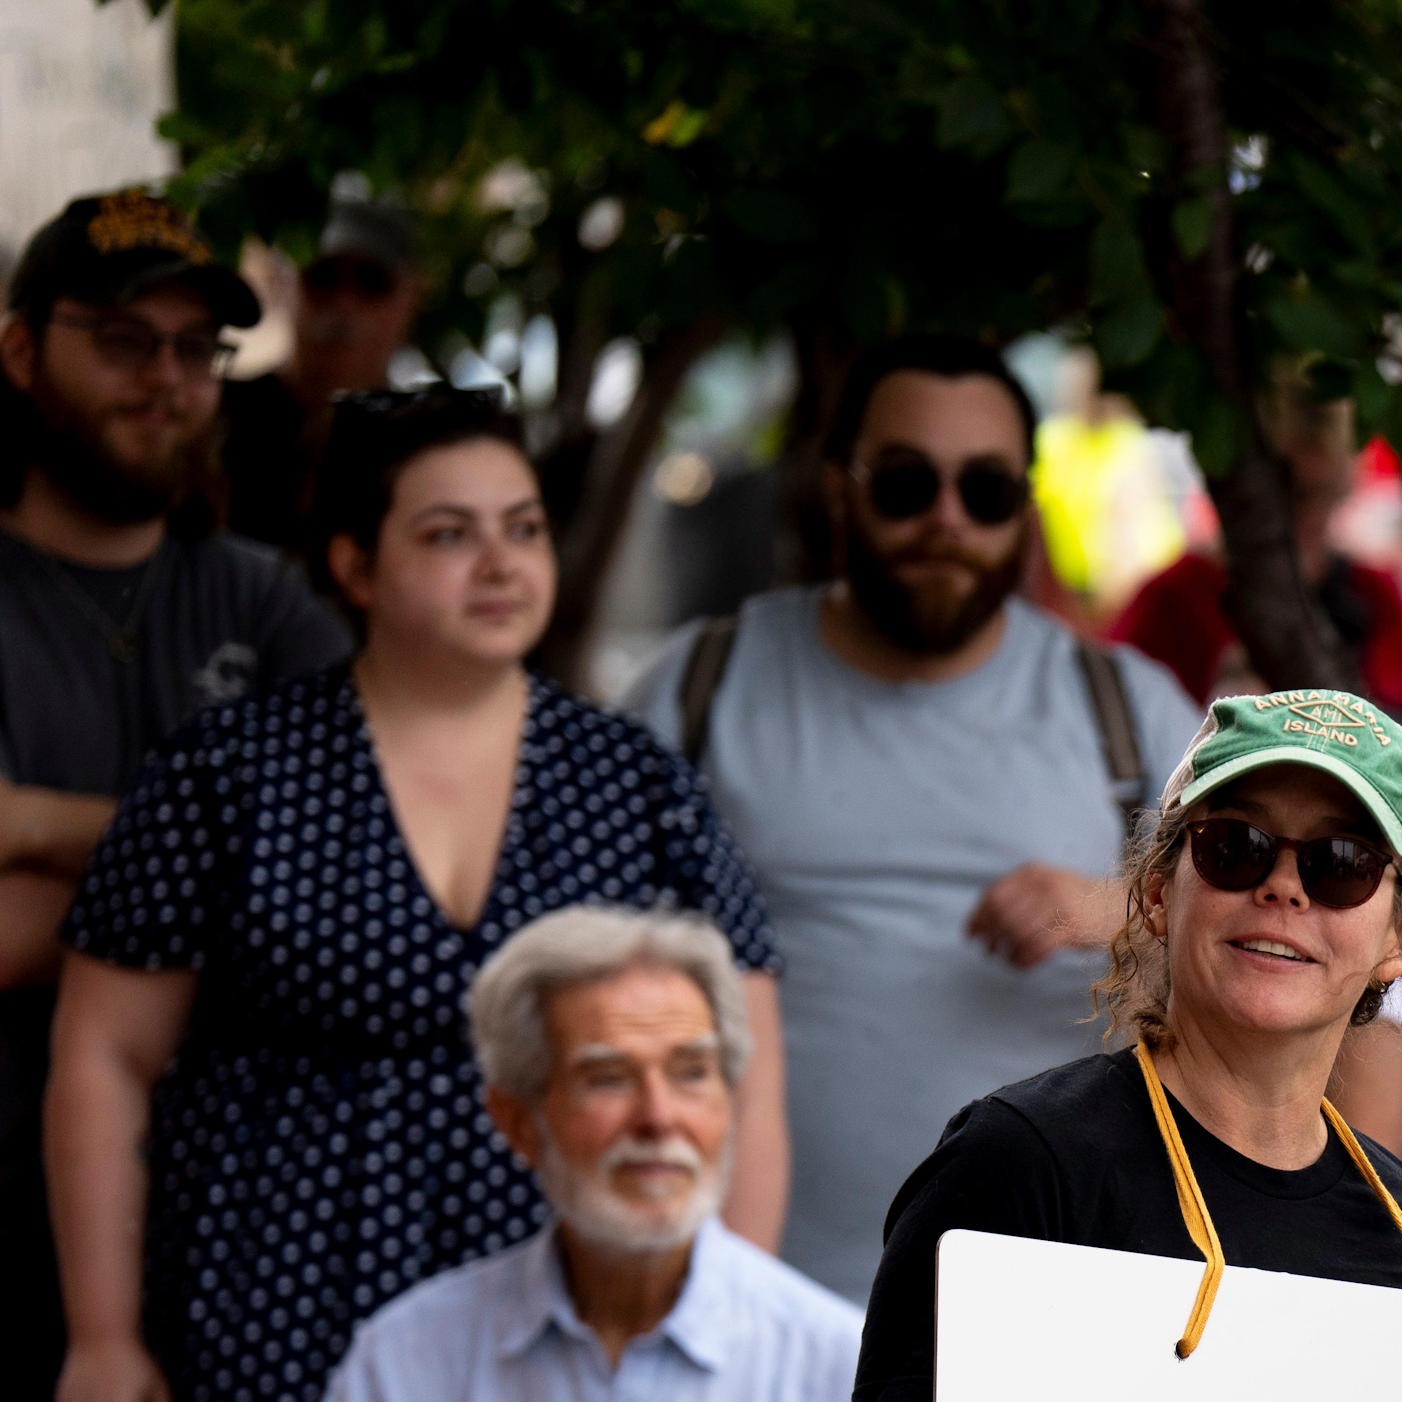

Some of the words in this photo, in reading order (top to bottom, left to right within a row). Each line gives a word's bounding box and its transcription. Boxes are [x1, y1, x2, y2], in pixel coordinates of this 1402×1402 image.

[1254, 688, 1321, 711] ANNA
[1333, 693, 1391, 747] MARIA
[1311, 704, 1344, 723] AMI
[1282, 718, 1358, 747] ISLAND
